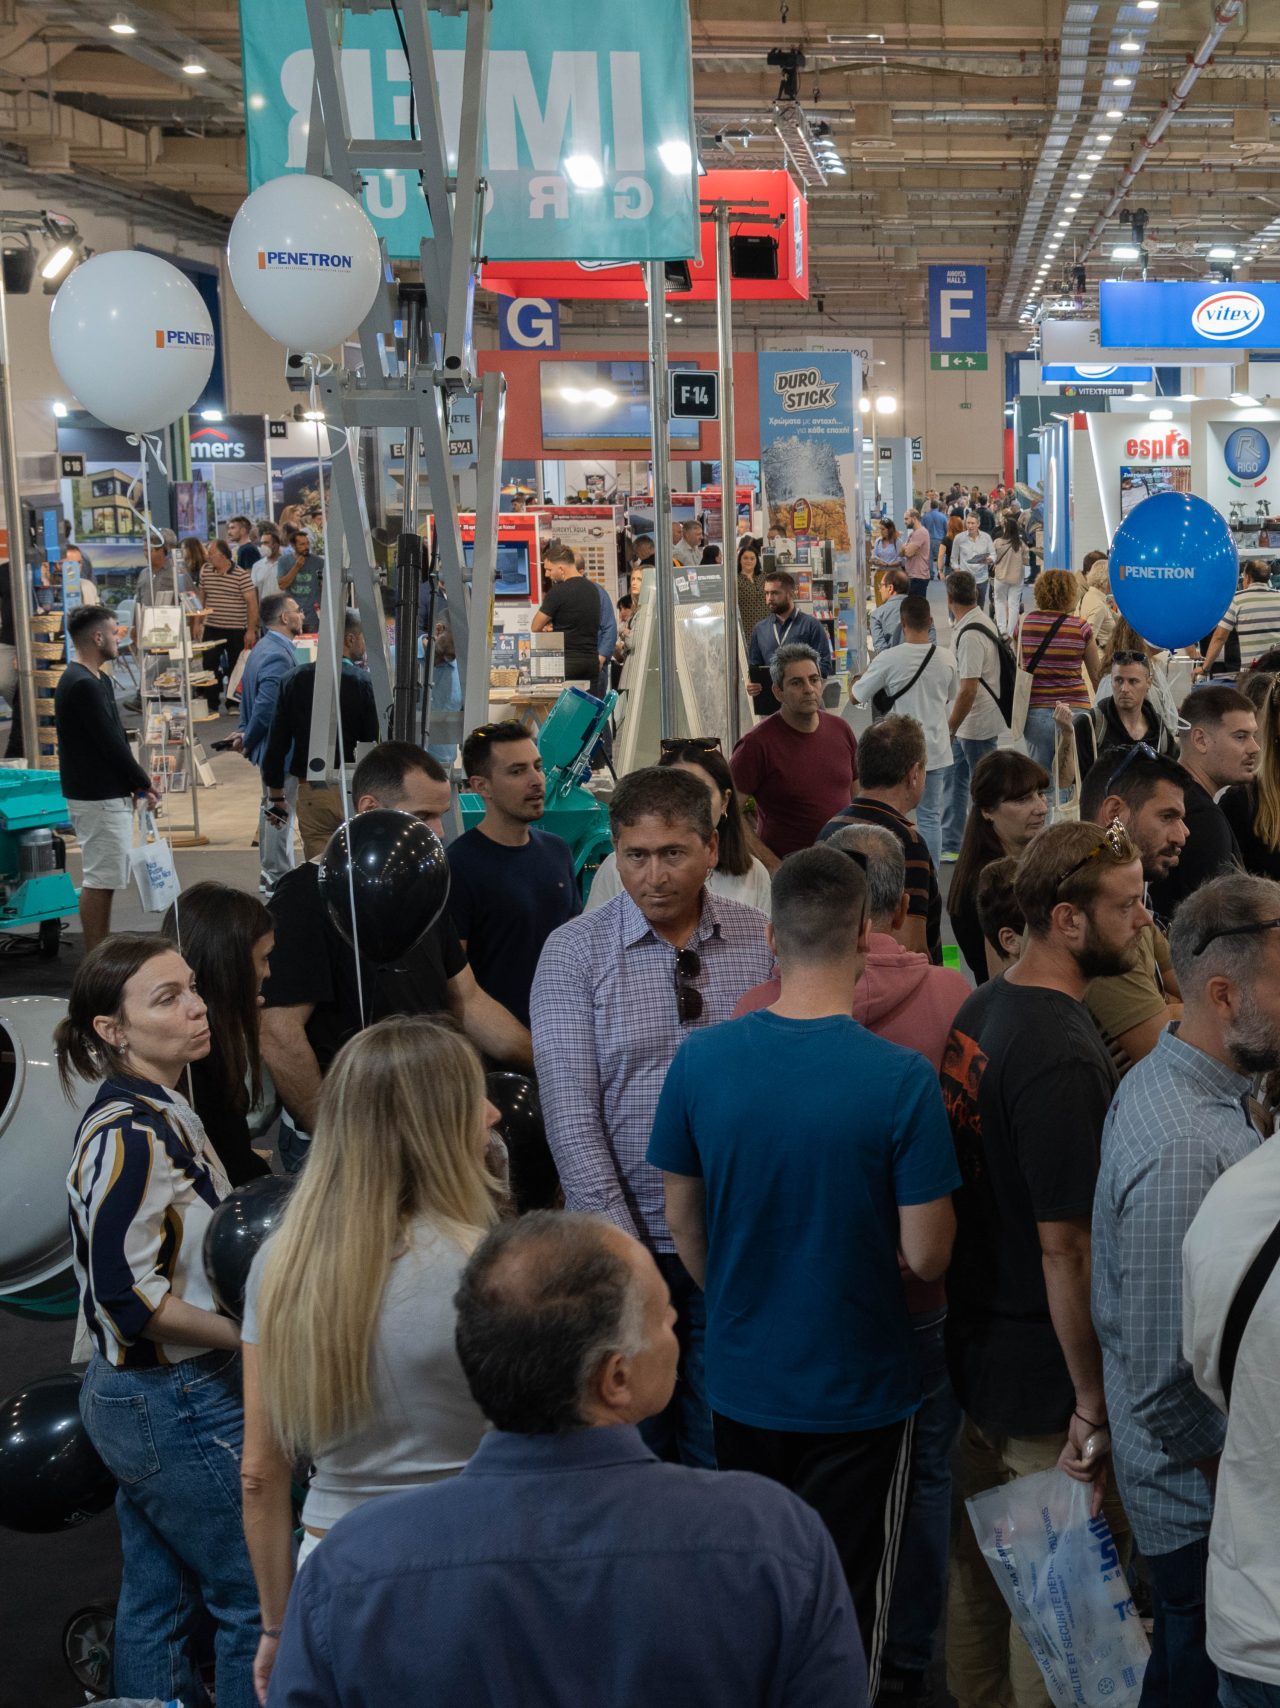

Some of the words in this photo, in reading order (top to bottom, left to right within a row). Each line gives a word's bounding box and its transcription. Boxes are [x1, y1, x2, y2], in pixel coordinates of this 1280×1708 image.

[267, 251, 352, 268] PENETRON
[940, 289, 974, 338] F
[1206, 305, 1253, 321] vitex
[507, 298, 554, 347] G
[777, 371, 817, 390] DURO
[786, 388, 832, 408] STICK
[1237, 462, 1259, 473] RIGO
[1125, 566, 1195, 579] PENETRON
